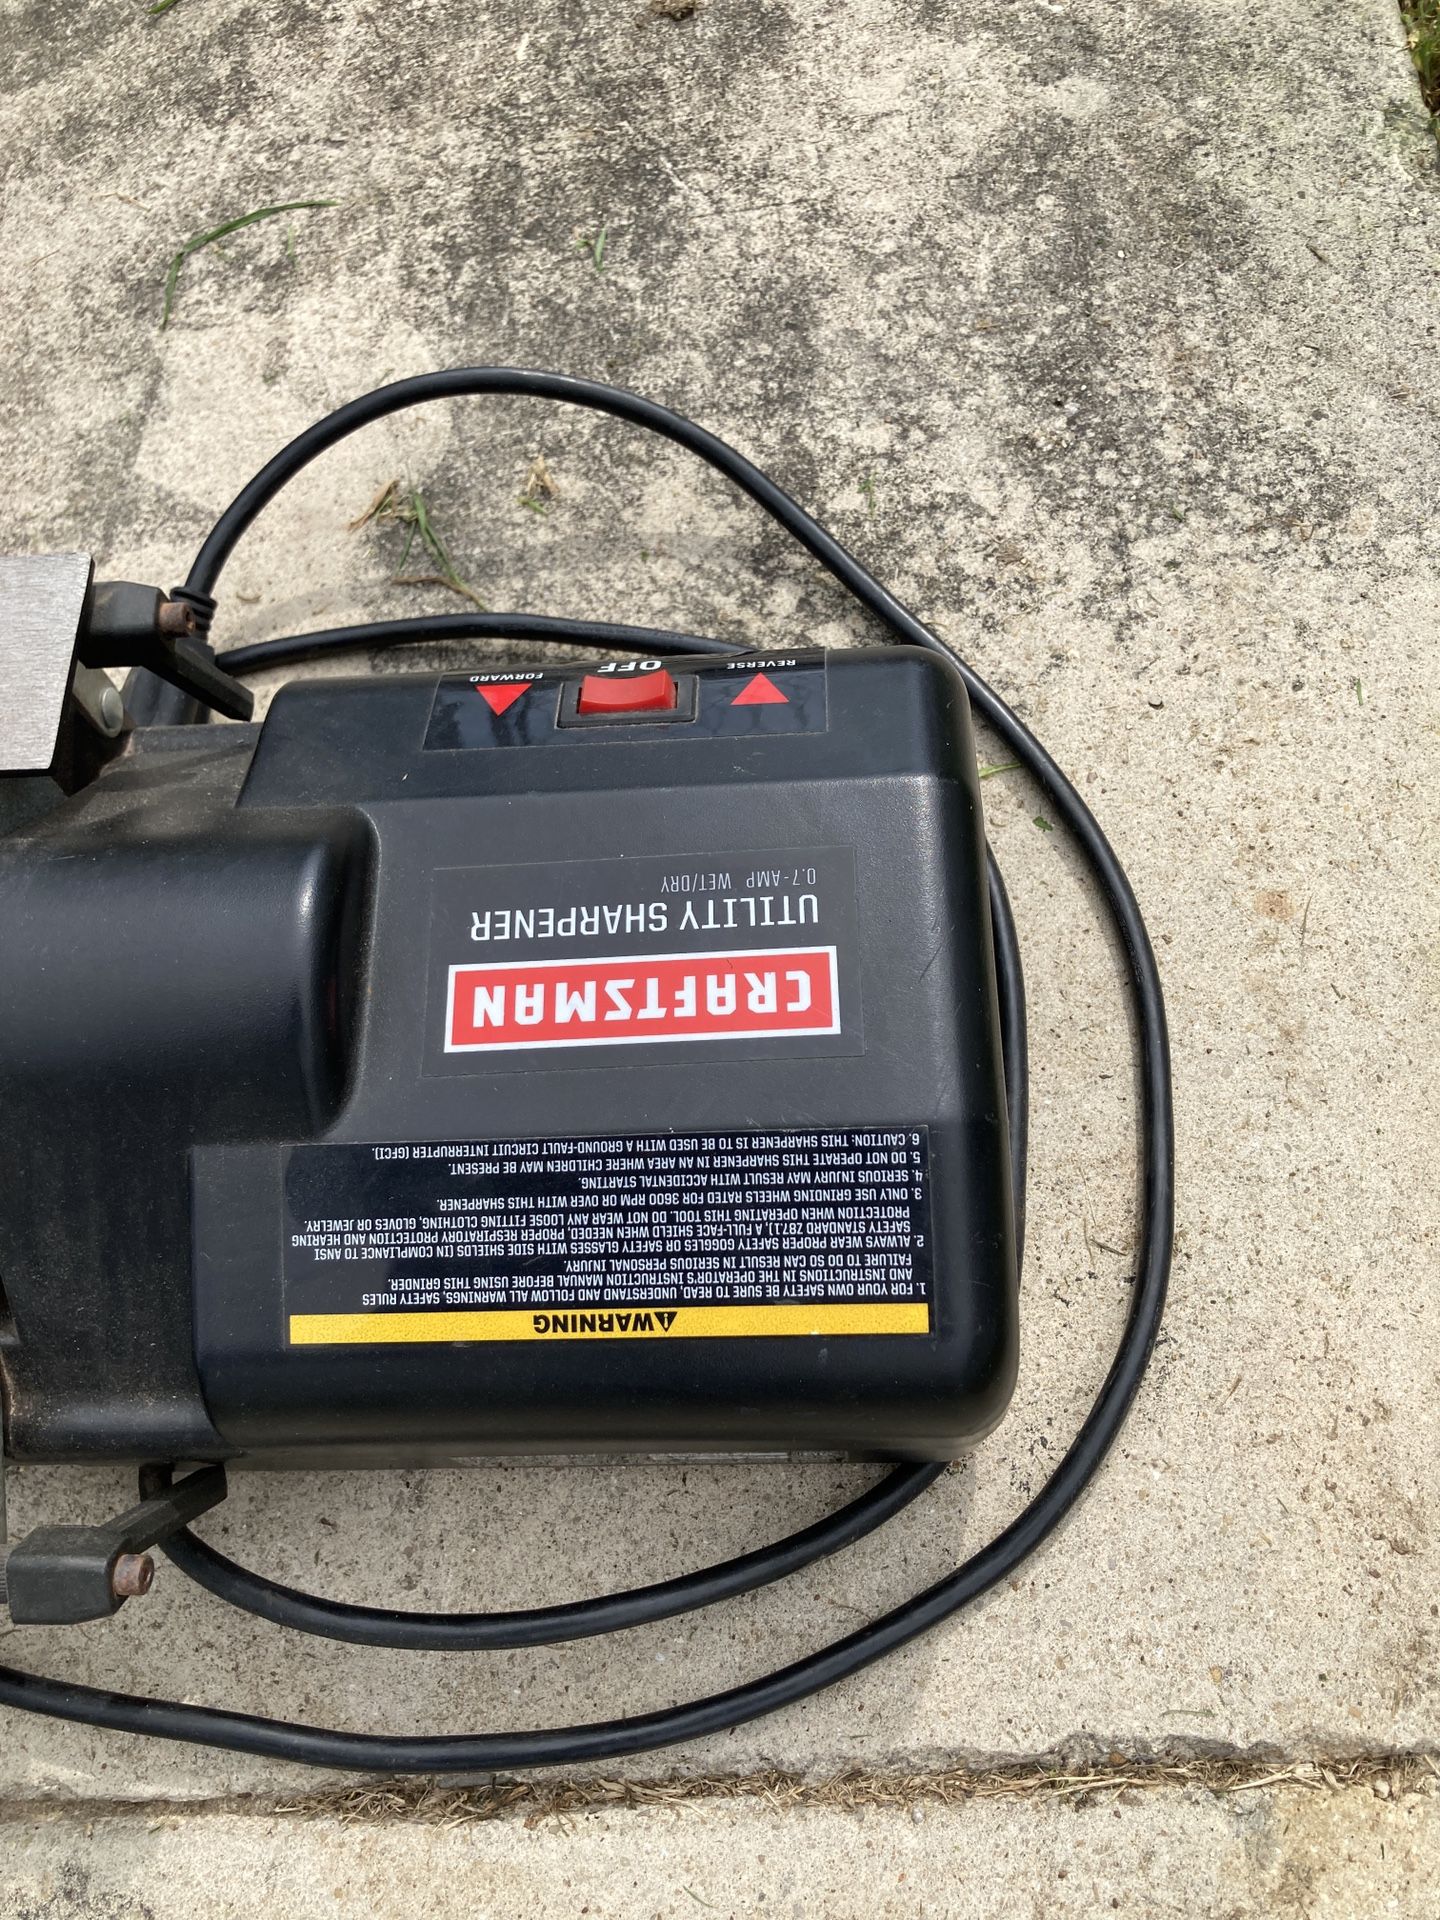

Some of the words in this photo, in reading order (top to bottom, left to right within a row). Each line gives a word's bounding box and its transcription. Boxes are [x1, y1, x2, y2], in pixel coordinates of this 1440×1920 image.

[598, 660, 662, 673] OFF
[727, 659, 796, 670] REVERSE
[470, 672, 544, 683] FORWARD
[661, 871, 731, 894] WET/DRY
[746, 867, 816, 888] 0.7-AMP
[680, 894, 819, 931] UTILITY
[470, 904, 667, 941] SHARPENER
[472, 970, 812, 1028] CRAFTSMAN
[636, 1140, 667, 1152] WITH
[669, 1139, 698, 1151] USED
[702, 1138, 715, 1150] BE
[719, 1138, 733, 1150] TO
[736, 1138, 748, 1149] IS
[752, 1136, 818, 1149] SHARPENER
[821, 1135, 849, 1147] THIS
[852, 1134, 906, 1147] CAUTION:
[909, 1133, 920, 1146] 6.
[413, 1145, 489, 1159] INTERRUPTER
[492, 1143, 539, 1156] CIRCUIT
[542, 1141, 623, 1155] GROUND-FAULT
[626, 1141, 634, 1152] A
[372, 1147, 409, 1160] (GFCI).
[783, 1154, 810, 1166] THIS
[813, 1153, 862, 1166] OPERATE
[866, 1152, 888, 1164] NOT
[891, 1152, 907, 1164] DO
[910, 1152, 921, 1164] 5.
[503, 1162, 517, 1174] BE
[520, 1161, 543, 1173] MAY
[547, 1159, 603, 1172] CHILDREN
[606, 1158, 645, 1171] WHERE
[647, 1157, 676, 1170] AREA
[679, 1157, 694, 1169] AN
[697, 1156, 710, 1168] IN
[713, 1155, 779, 1168] SHARPENER
[448, 1162, 500, 1175] PRESENT.
[578, 1176, 637, 1189] STARTING.
[639, 1175, 708, 1187] ACCIDENTAL
[711, 1174, 741, 1186] WITH
[743, 1172, 784, 1185] RESULT
[787, 1172, 811, 1184] MAY
[814, 1171, 855, 1184] INJURY
[858, 1170, 909, 1183] SERIOUS
[912, 1170, 923, 1182] 4.
[621, 1194, 646, 1206] RPM
[649, 1193, 680, 1205] 3600
[683, 1192, 704, 1205] FOR
[707, 1192, 742, 1204] RATED
[745, 1190, 791, 1203] WHEELS
[794, 1189, 852, 1202] GRINDING
[855, 1189, 877, 1201] USE
[880, 1188, 908, 1200] ONLY
[911, 1188, 922, 1200] 3.
[437, 1198, 505, 1211] SHARPENER.
[508, 1197, 535, 1209] THIS
[538, 1196, 568, 1208] WITH
[571, 1195, 599, 1207] OVER
[602, 1195, 617, 1207] OR
[567, 1214, 589, 1225] ANY
[592, 1213, 624, 1225] WEAR
[626, 1212, 648, 1224] NOT
[652, 1211, 667, 1224] DO
[670, 1210, 701, 1223] TOOL.
[704, 1210, 732, 1222] THIS
[734, 1208, 798, 1221] OPERATING
[802, 1208, 835, 1220] WHEN
[838, 1206, 910, 1220] PROTECTION
[304, 1220, 355, 1232] JEWELRY.
[357, 1219, 372, 1231] OR
[375, 1218, 416, 1231] GLOVES
[419, 1215, 478, 1229] CLOTHING,
[481, 1215, 526, 1228] FITTING
[529, 1214, 564, 1226] LOOSE
[568, 1226, 613, 1240] NEEDED,
[617, 1226, 649, 1239] WHEN
[652, 1225, 693, 1238] SHIELD
[696, 1224, 752, 1237] FULL-FACE
[755, 1224, 763, 1236] A
[766, 1222, 803, 1236] Z87.1),
[806, 1221, 866, 1235] STANDARD
[869, 1221, 911, 1234] SAFETY
[292, 1234, 341, 1247] HEARING
[344, 1234, 366, 1246] AND
[369, 1232, 438, 1245] PROTECTION
[441, 1230, 518, 1243] RESPIRATORY
[521, 1228, 564, 1241] PROPER
[914, 1235, 924, 1247] 2.
[571, 1242, 619, 1254] GLASSES
[622, 1240, 663, 1253] SAFETY
[666, 1240, 681, 1252] OR
[684, 1239, 735, 1252] GOGGLES
[738, 1238, 779, 1250] SAFETY
[782, 1237, 827, 1250] PROPER
[830, 1236, 863, 1249] WEAR
[866, 1235, 911, 1248] ALWAYS
[314, 1248, 342, 1261] ANSI
[344, 1248, 359, 1260] TO
[361, 1246, 433, 1259] COMPLIANCE
[437, 1245, 454, 1258] (IN
[457, 1244, 505, 1257] SHIELDS
[508, 1244, 534, 1256] SIDE
[538, 1243, 567, 1255] WITH
[564, 1260, 606, 1272] INJURY.
[609, 1259, 667, 1271] PERSONAL
[670, 1257, 720, 1270] SERIOUS
[723, 1257, 736, 1269] IN
[739, 1256, 780, 1269] RESULT
[784, 1255, 806, 1268] CAN
[810, 1255, 825, 1267] SO
[828, 1255, 844, 1267] DO
[847, 1254, 862, 1267] TO
[865, 1254, 912, 1266] FAILURE
[557, 1274, 603, 1287] MANUAL
[607, 1273, 684, 1286] INSTRUCTION
[687, 1271, 755, 1284] OPERATOR'S
[759, 1270, 780, 1283] THE
[783, 1270, 796, 1282] IN
[800, 1269, 886, 1282] INSTRUCTIONS
[889, 1268, 913, 1281] AND
[388, 1278, 440, 1291] GRINDER.
[444, 1278, 471, 1289] THIS
[473, 1277, 509, 1289] USING
[512, 1275, 554, 1288] BEFORE
[531, 1289, 575, 1302] FOLLOW
[578, 1289, 601, 1301] AND
[604, 1287, 677, 1301] UNDERSTAND
[680, 1285, 712, 1299] READ,
[716, 1286, 730, 1298] TO
[733, 1285, 762, 1298] SURE
[766, 1285, 780, 1297] BE
[783, 1284, 824, 1297] SAFETY
[828, 1284, 854, 1296] OWN
[857, 1283, 888, 1296] YOUR
[891, 1283, 913, 1295] FOR
[916, 1283, 926, 1295] 1.
[363, 1293, 397, 1306] RULES
[400, 1292, 440, 1305] SAFETY
[443, 1290, 507, 1304] WARNINGS,
[509, 1291, 528, 1302] ALL
[532, 1313, 655, 1334] WARNING
